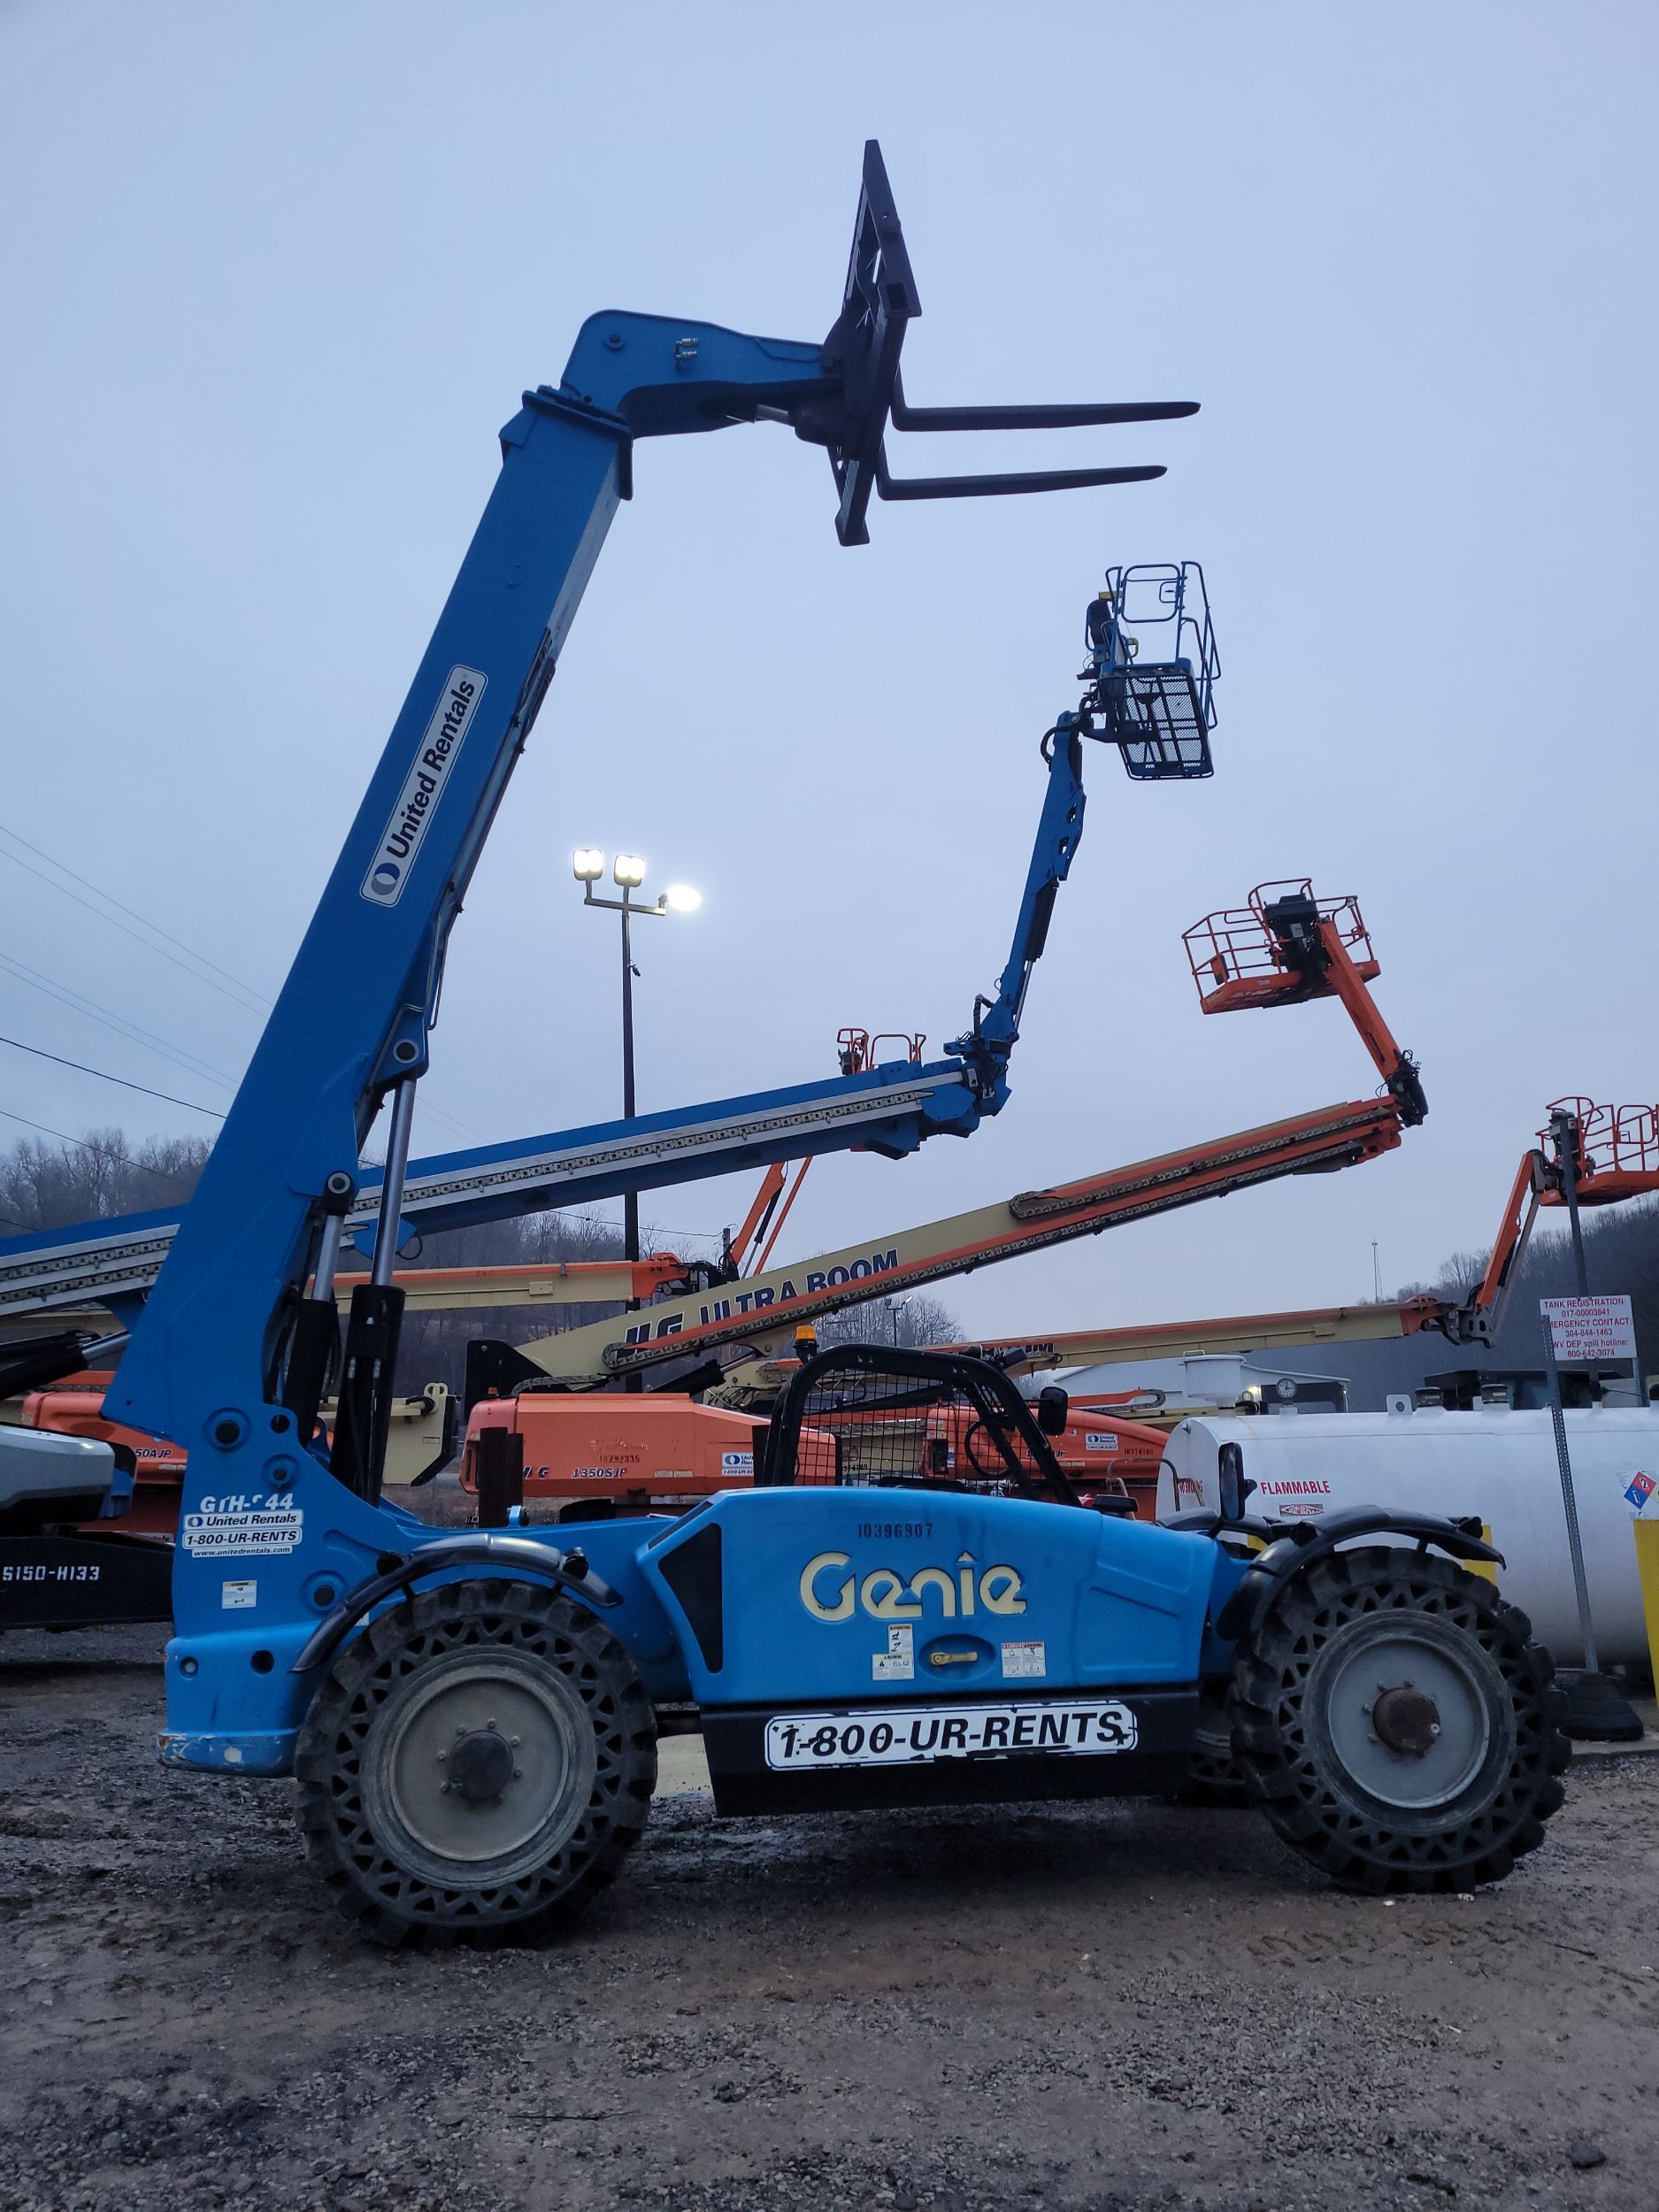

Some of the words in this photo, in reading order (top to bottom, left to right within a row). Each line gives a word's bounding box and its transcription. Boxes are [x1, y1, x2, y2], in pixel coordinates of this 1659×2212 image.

[386, 771, 437, 859] United
[422, 680, 476, 772] Rentals
[1567, 1298, 1626, 1308] REGISTRATION:
[1549, 1319, 1591, 1328] MERGENCY
[1592, 1317, 1632, 1326] CONTACT:
[1566, 1340, 1582, 1348] DEP
[1584, 1339, 1599, 1348] spill
[1601, 1338, 1629, 1347] hotline:
[133, 1448, 172, 1458] 50AJP
[1260, 1480, 1332, 1494] FLAMMABLE
[1640, 1478, 1650, 1490] 2
[1632, 1490, 1640, 1504] 1
[206, 1515, 248, 1527] United
[251, 1513, 296, 1525] Rentals
[857, 1522, 933, 1539] 10396907
[187, 1531, 297, 1545] 1-800-UR-RENTS
[194, 1547, 290, 1556] www.unitedrentals.com
[799, 1549, 1027, 1623] Genie
[780, 1710, 1125, 1759] 1-800-UR-RENTS
